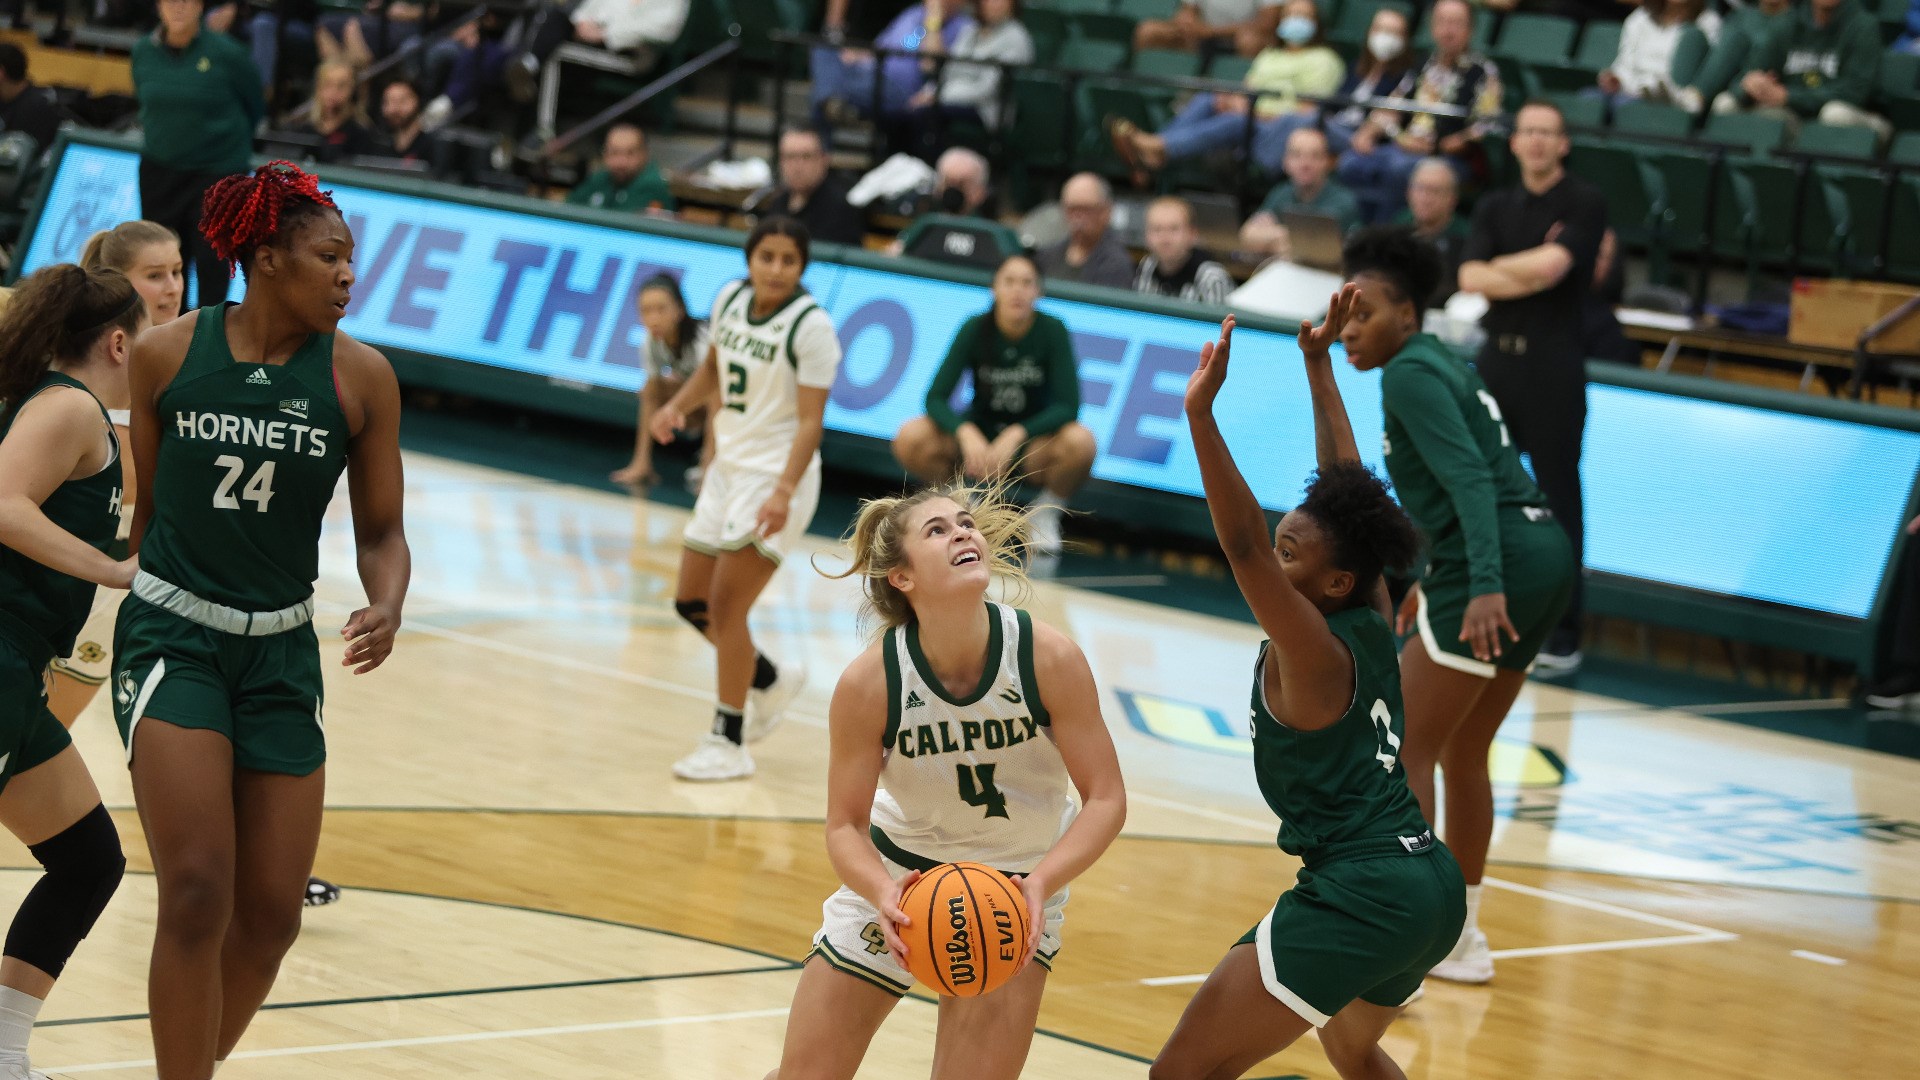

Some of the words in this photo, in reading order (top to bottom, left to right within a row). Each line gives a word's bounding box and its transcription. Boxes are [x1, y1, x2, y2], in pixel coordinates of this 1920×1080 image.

[245, 377, 272, 386] adidas
[727, 361, 748, 413] 2
[176, 411, 329, 458] HORNETS
[212, 454, 276, 513] 24
[898, 720, 960, 759] CAL
[960, 716, 1038, 752] POLY
[956, 763, 1011, 820] 4
[945, 895, 976, 986] Wilson
[993, 910, 1015, 961] EVO
